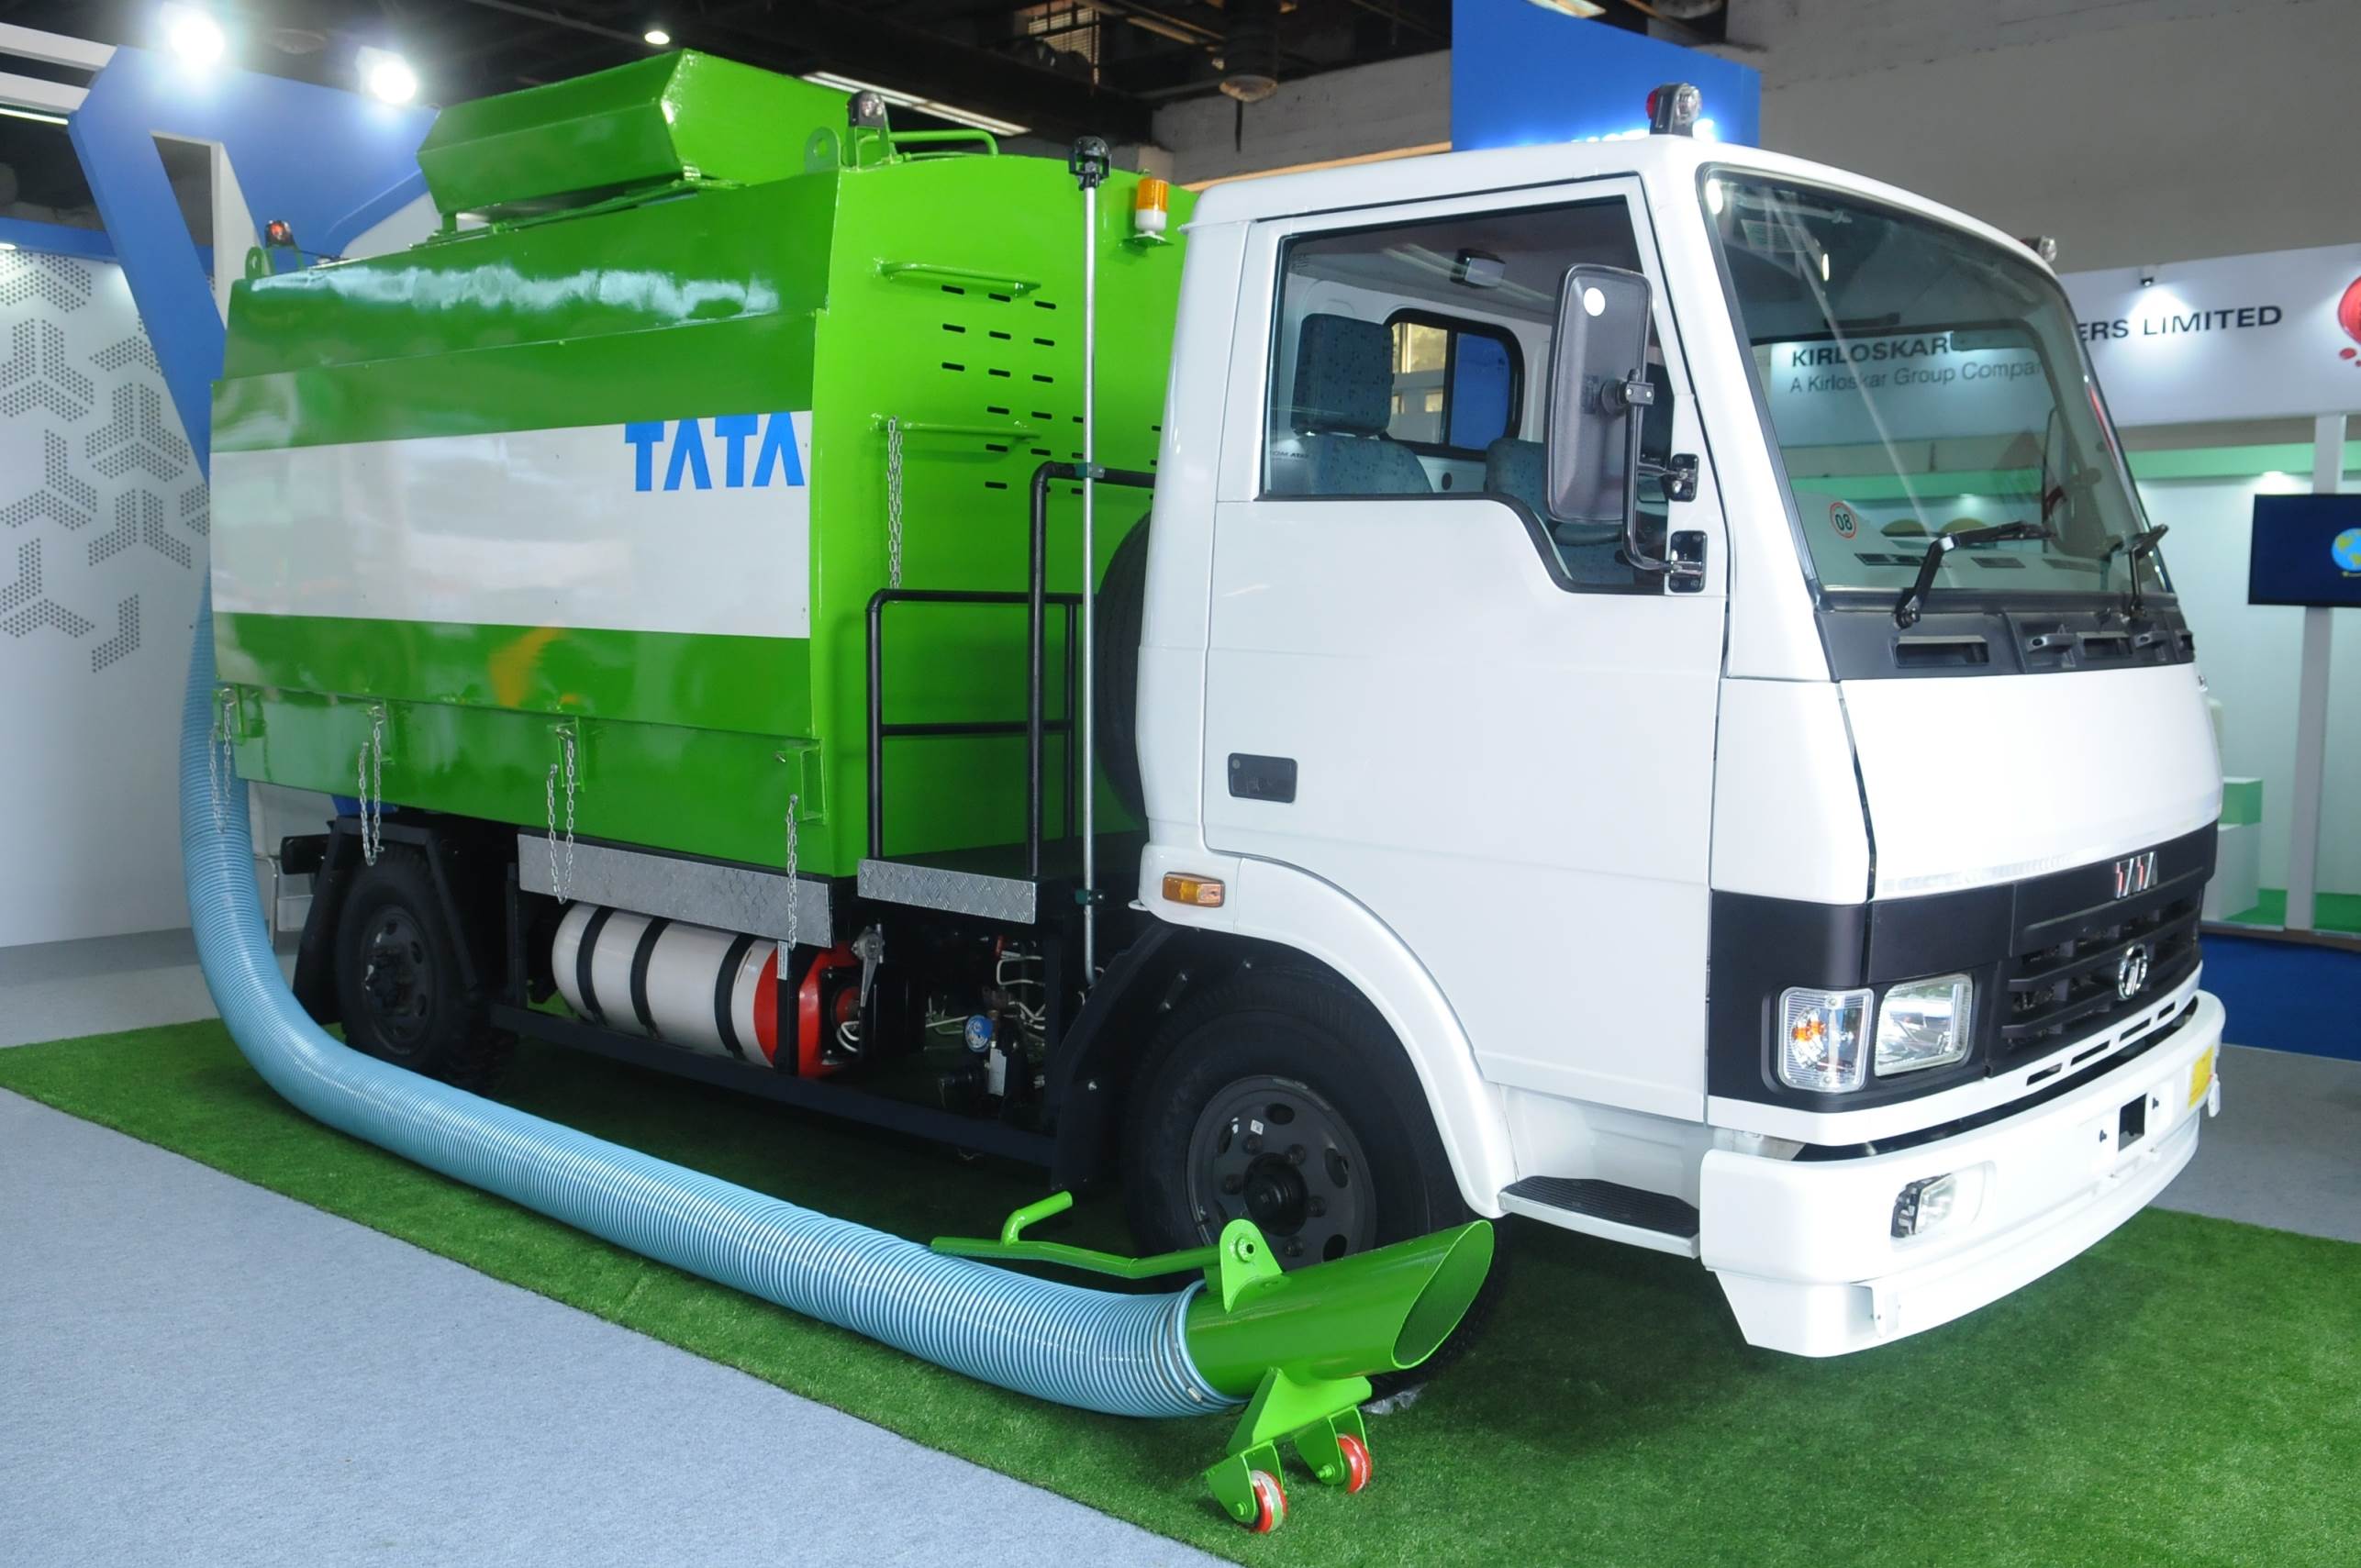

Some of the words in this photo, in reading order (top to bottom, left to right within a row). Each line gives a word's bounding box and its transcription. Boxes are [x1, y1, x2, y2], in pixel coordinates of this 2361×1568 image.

[1792, 337, 1949, 367] KIRLOSKAR
[2077, 319, 2130, 342] ERS
[2144, 306, 2282, 335] LIMITED
[1790, 378, 1802, 393] A
[1894, 366, 1955, 387] Group
[625, 411, 805, 492] TATA
[1835, 513, 1853, 531] 08
